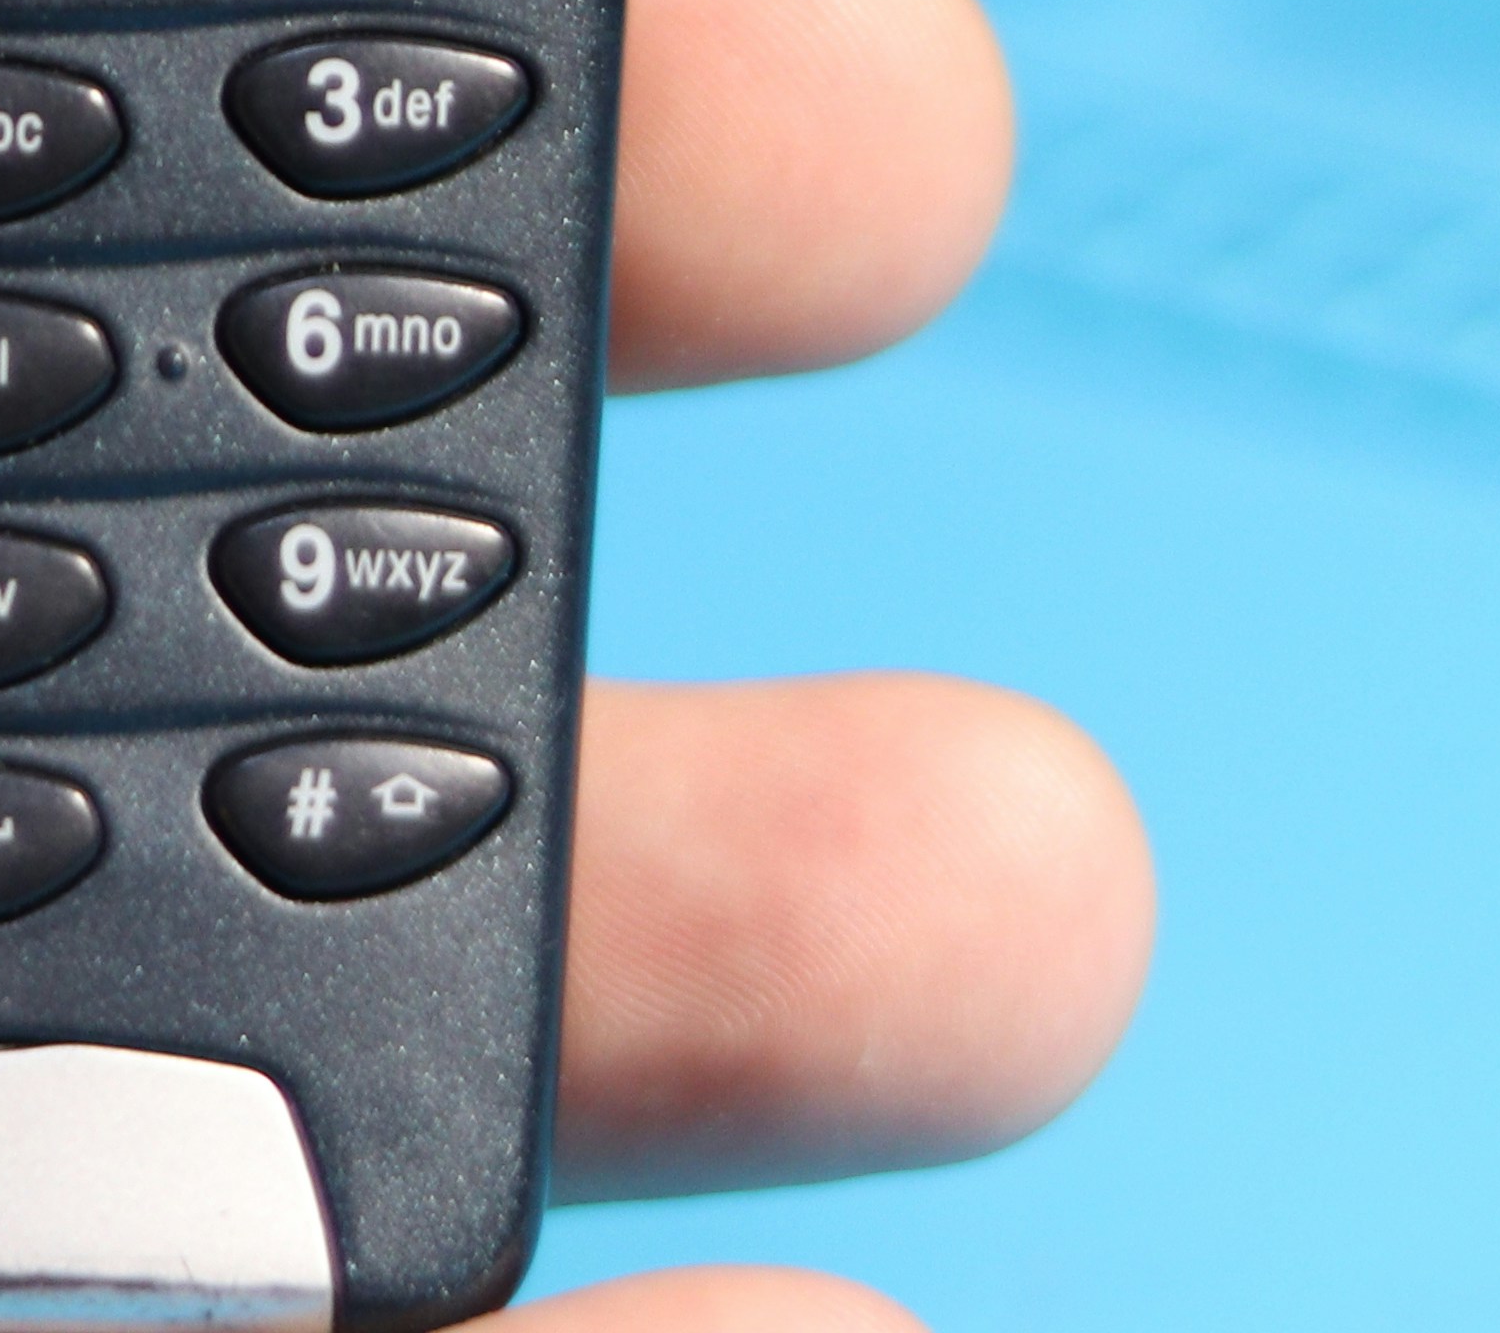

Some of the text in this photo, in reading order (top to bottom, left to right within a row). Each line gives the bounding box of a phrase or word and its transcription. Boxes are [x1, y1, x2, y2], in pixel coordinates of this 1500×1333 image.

[304, 57, 456, 146] 3 def
[285, 287, 463, 377] 6 mno
[279, 522, 468, 611] 9 wxyz
